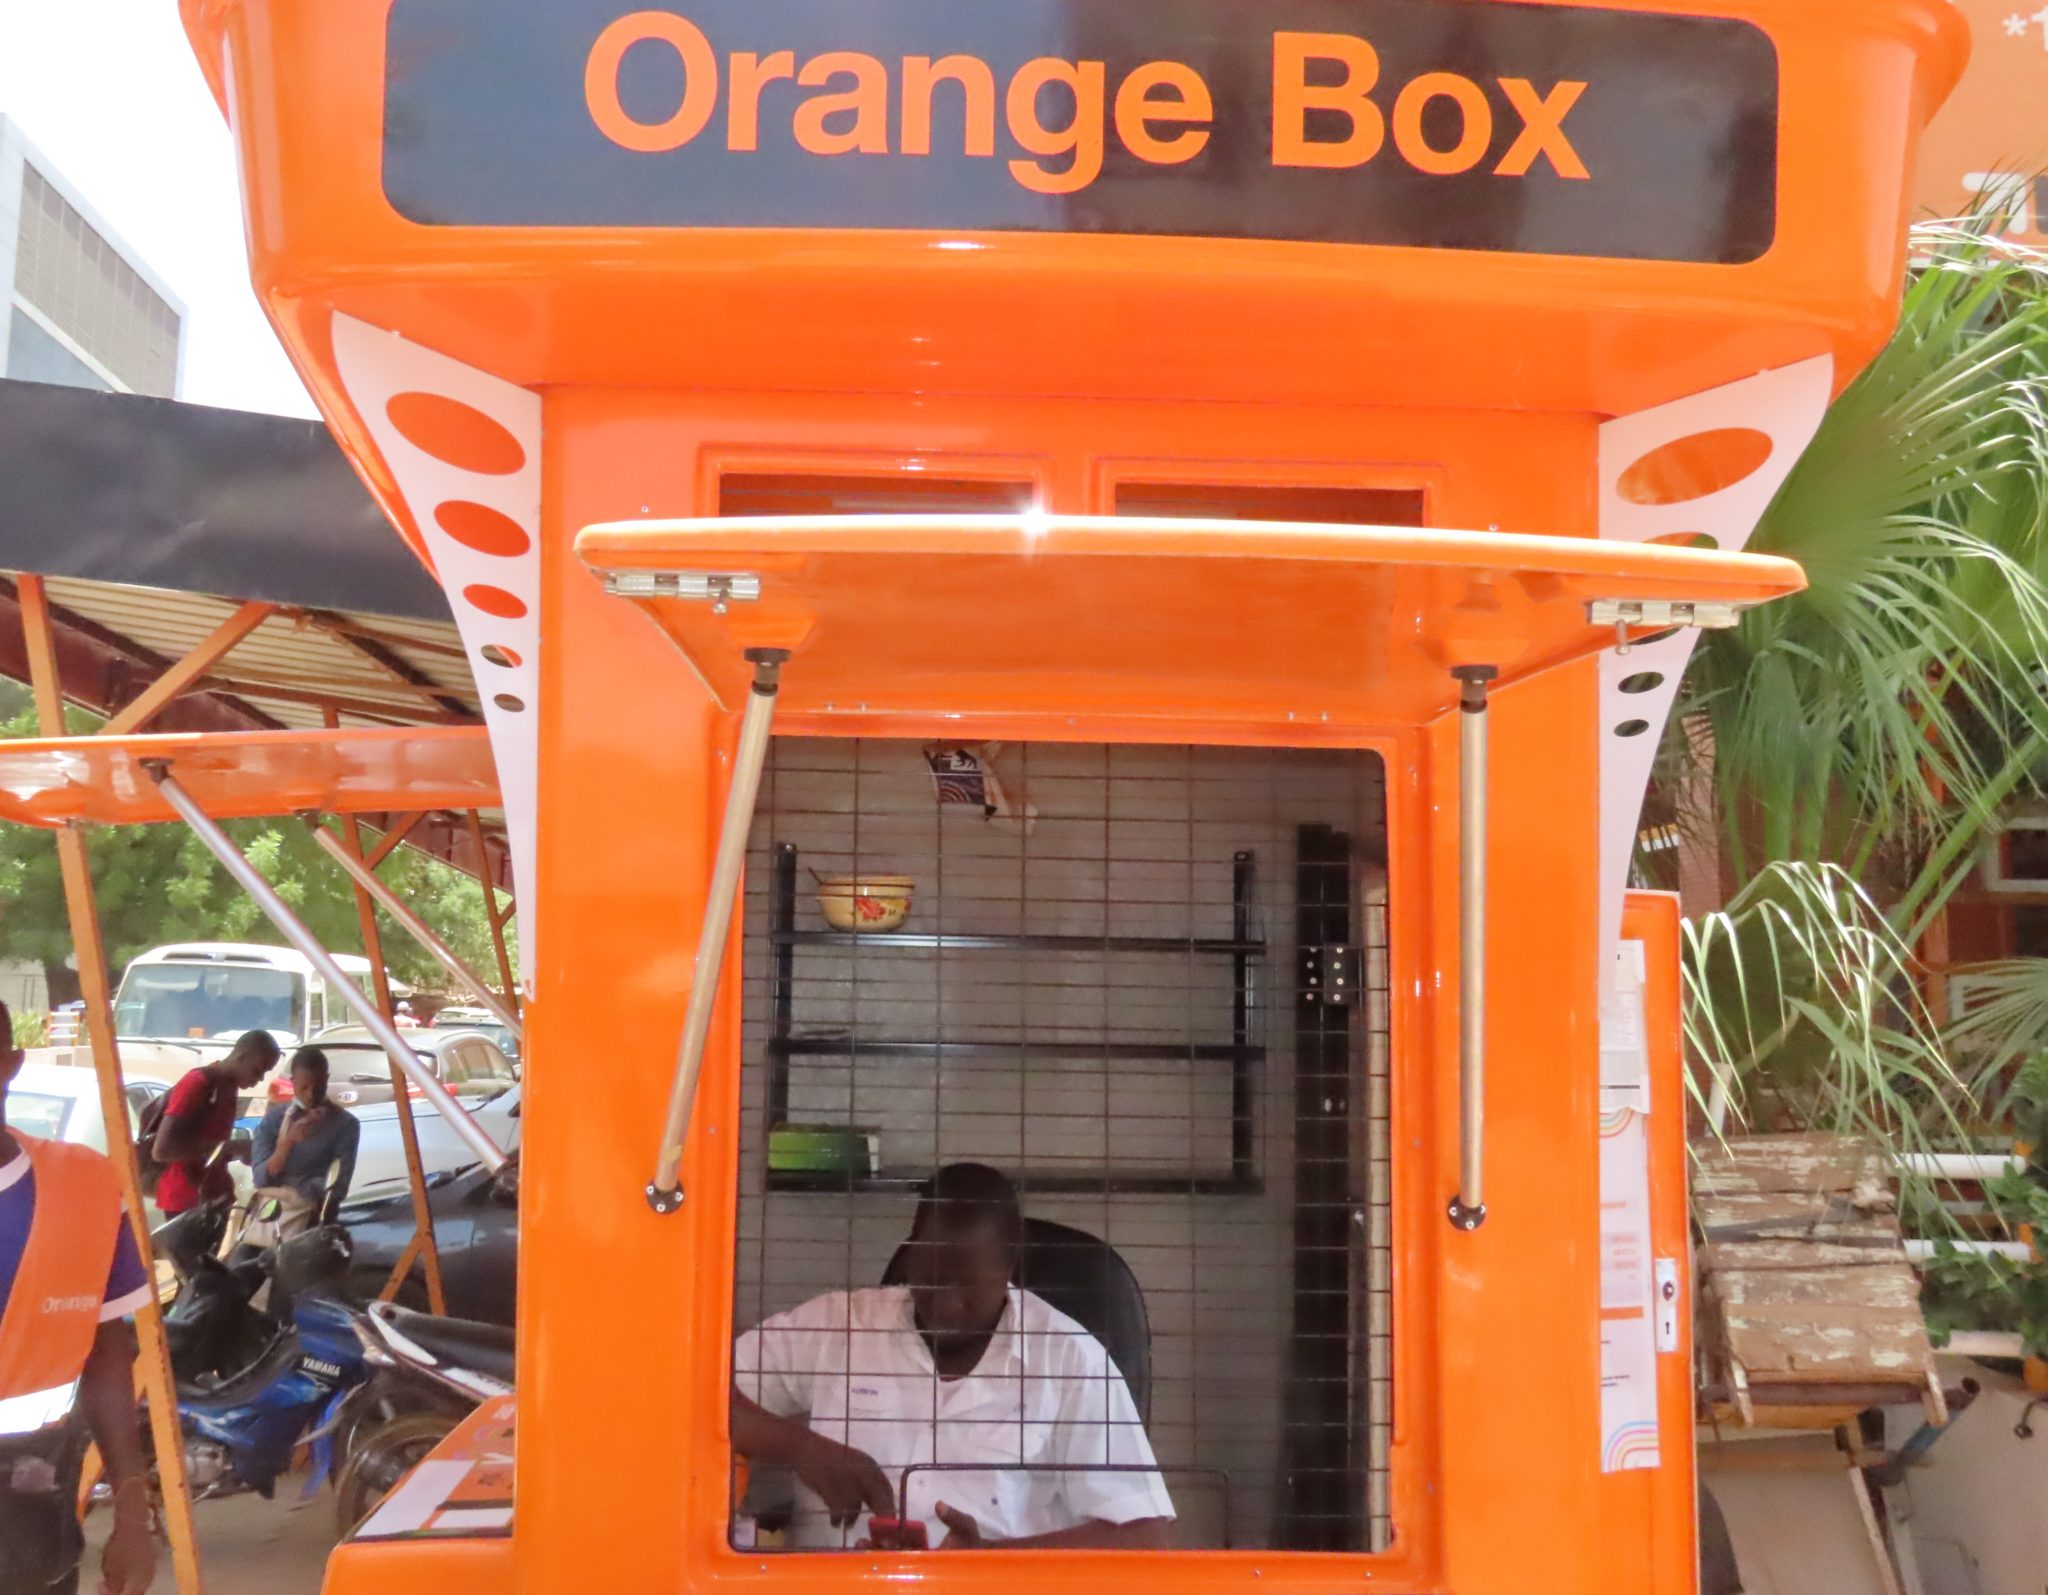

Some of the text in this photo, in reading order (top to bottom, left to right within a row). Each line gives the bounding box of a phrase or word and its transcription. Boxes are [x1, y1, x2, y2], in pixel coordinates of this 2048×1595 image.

[584, 10, 1590, 194] Orange Box
[41, 1294, 98, 1314] Orange
[302, 1357, 341, 1377] YAMAHA
